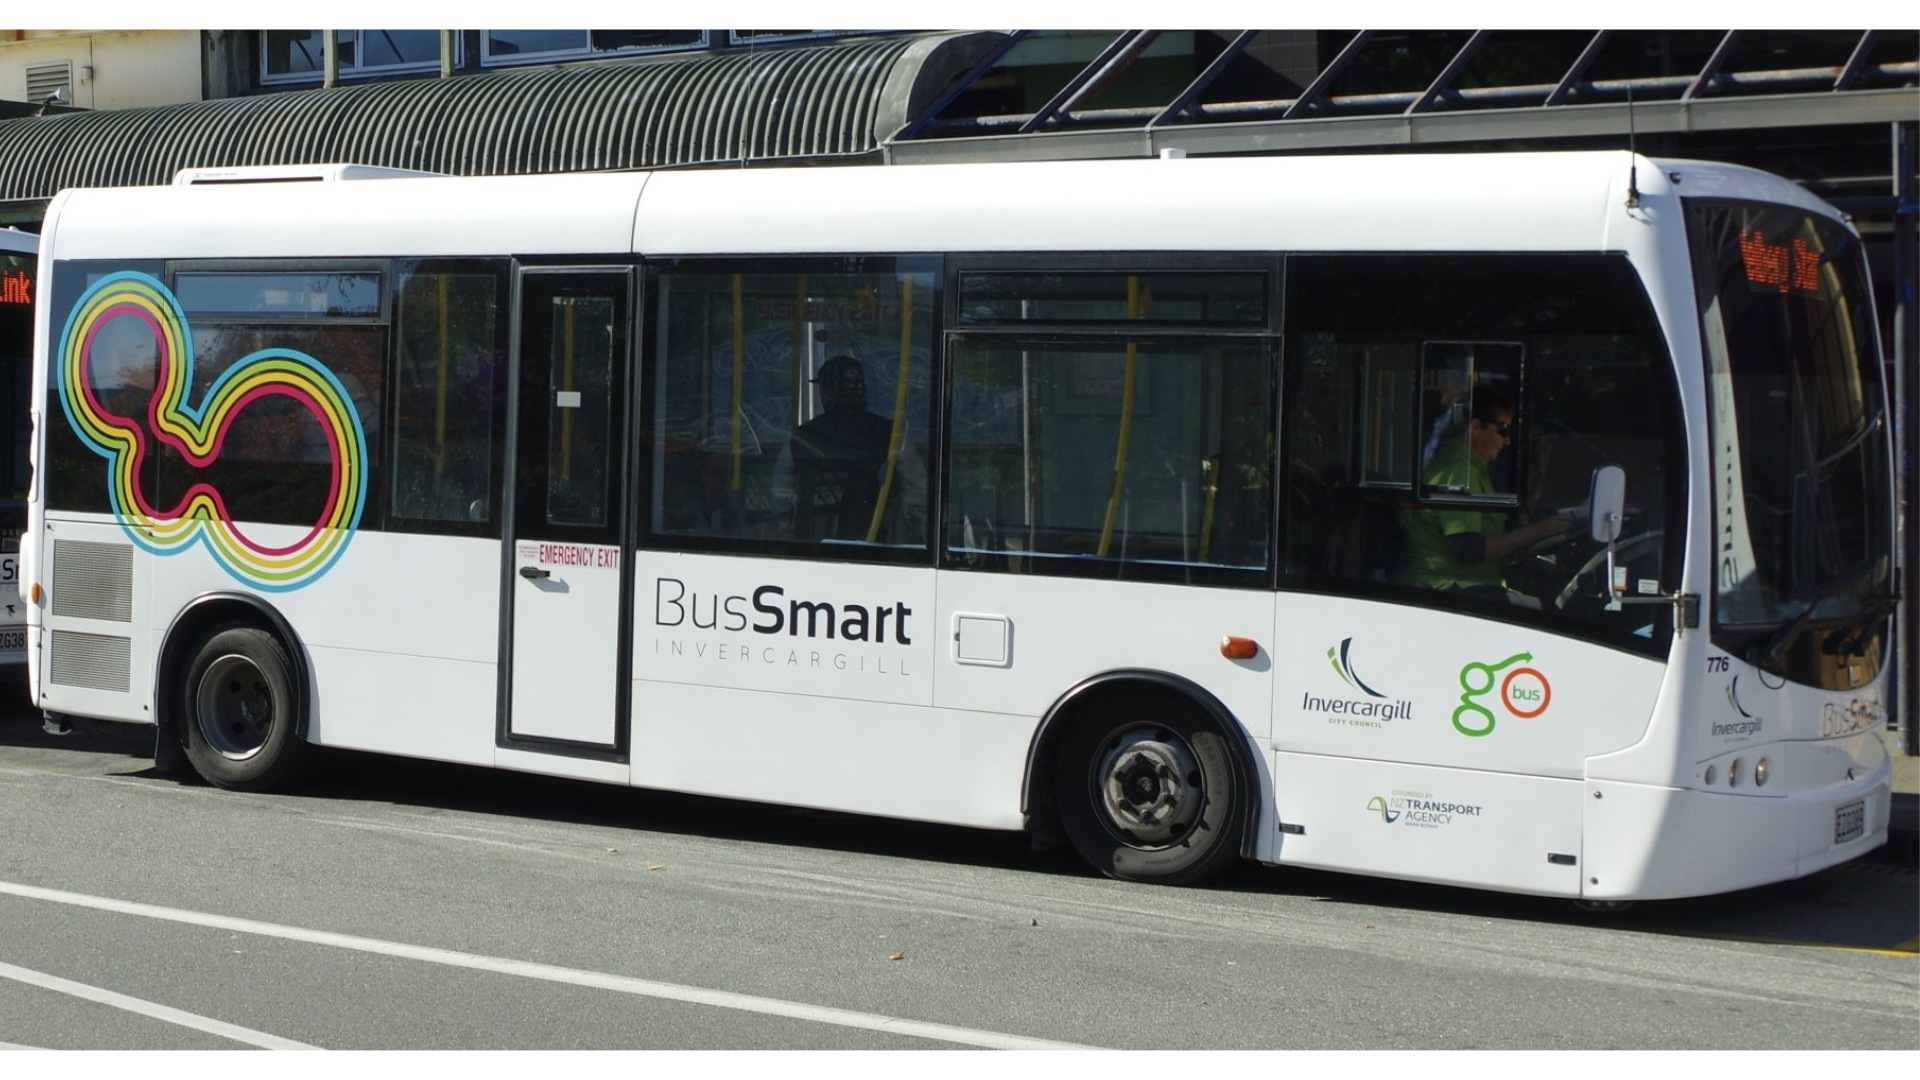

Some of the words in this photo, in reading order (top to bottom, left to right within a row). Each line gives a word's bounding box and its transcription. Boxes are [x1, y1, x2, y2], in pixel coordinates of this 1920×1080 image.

[540, 544, 594, 567] EMERGENCY
[598, 548, 619, 569] EXIT
[656, 577, 912, 646] BusSmart
[655, 638, 910, 676] INVERCARGILL
[1707, 656, 1730, 673] 776
[1512, 684, 1540, 701] bus
[1302, 692, 1412, 722] Invercargill
[1349, 720, 1383, 729] COUNCIL
[1405, 810, 1452, 825] AGENCY
